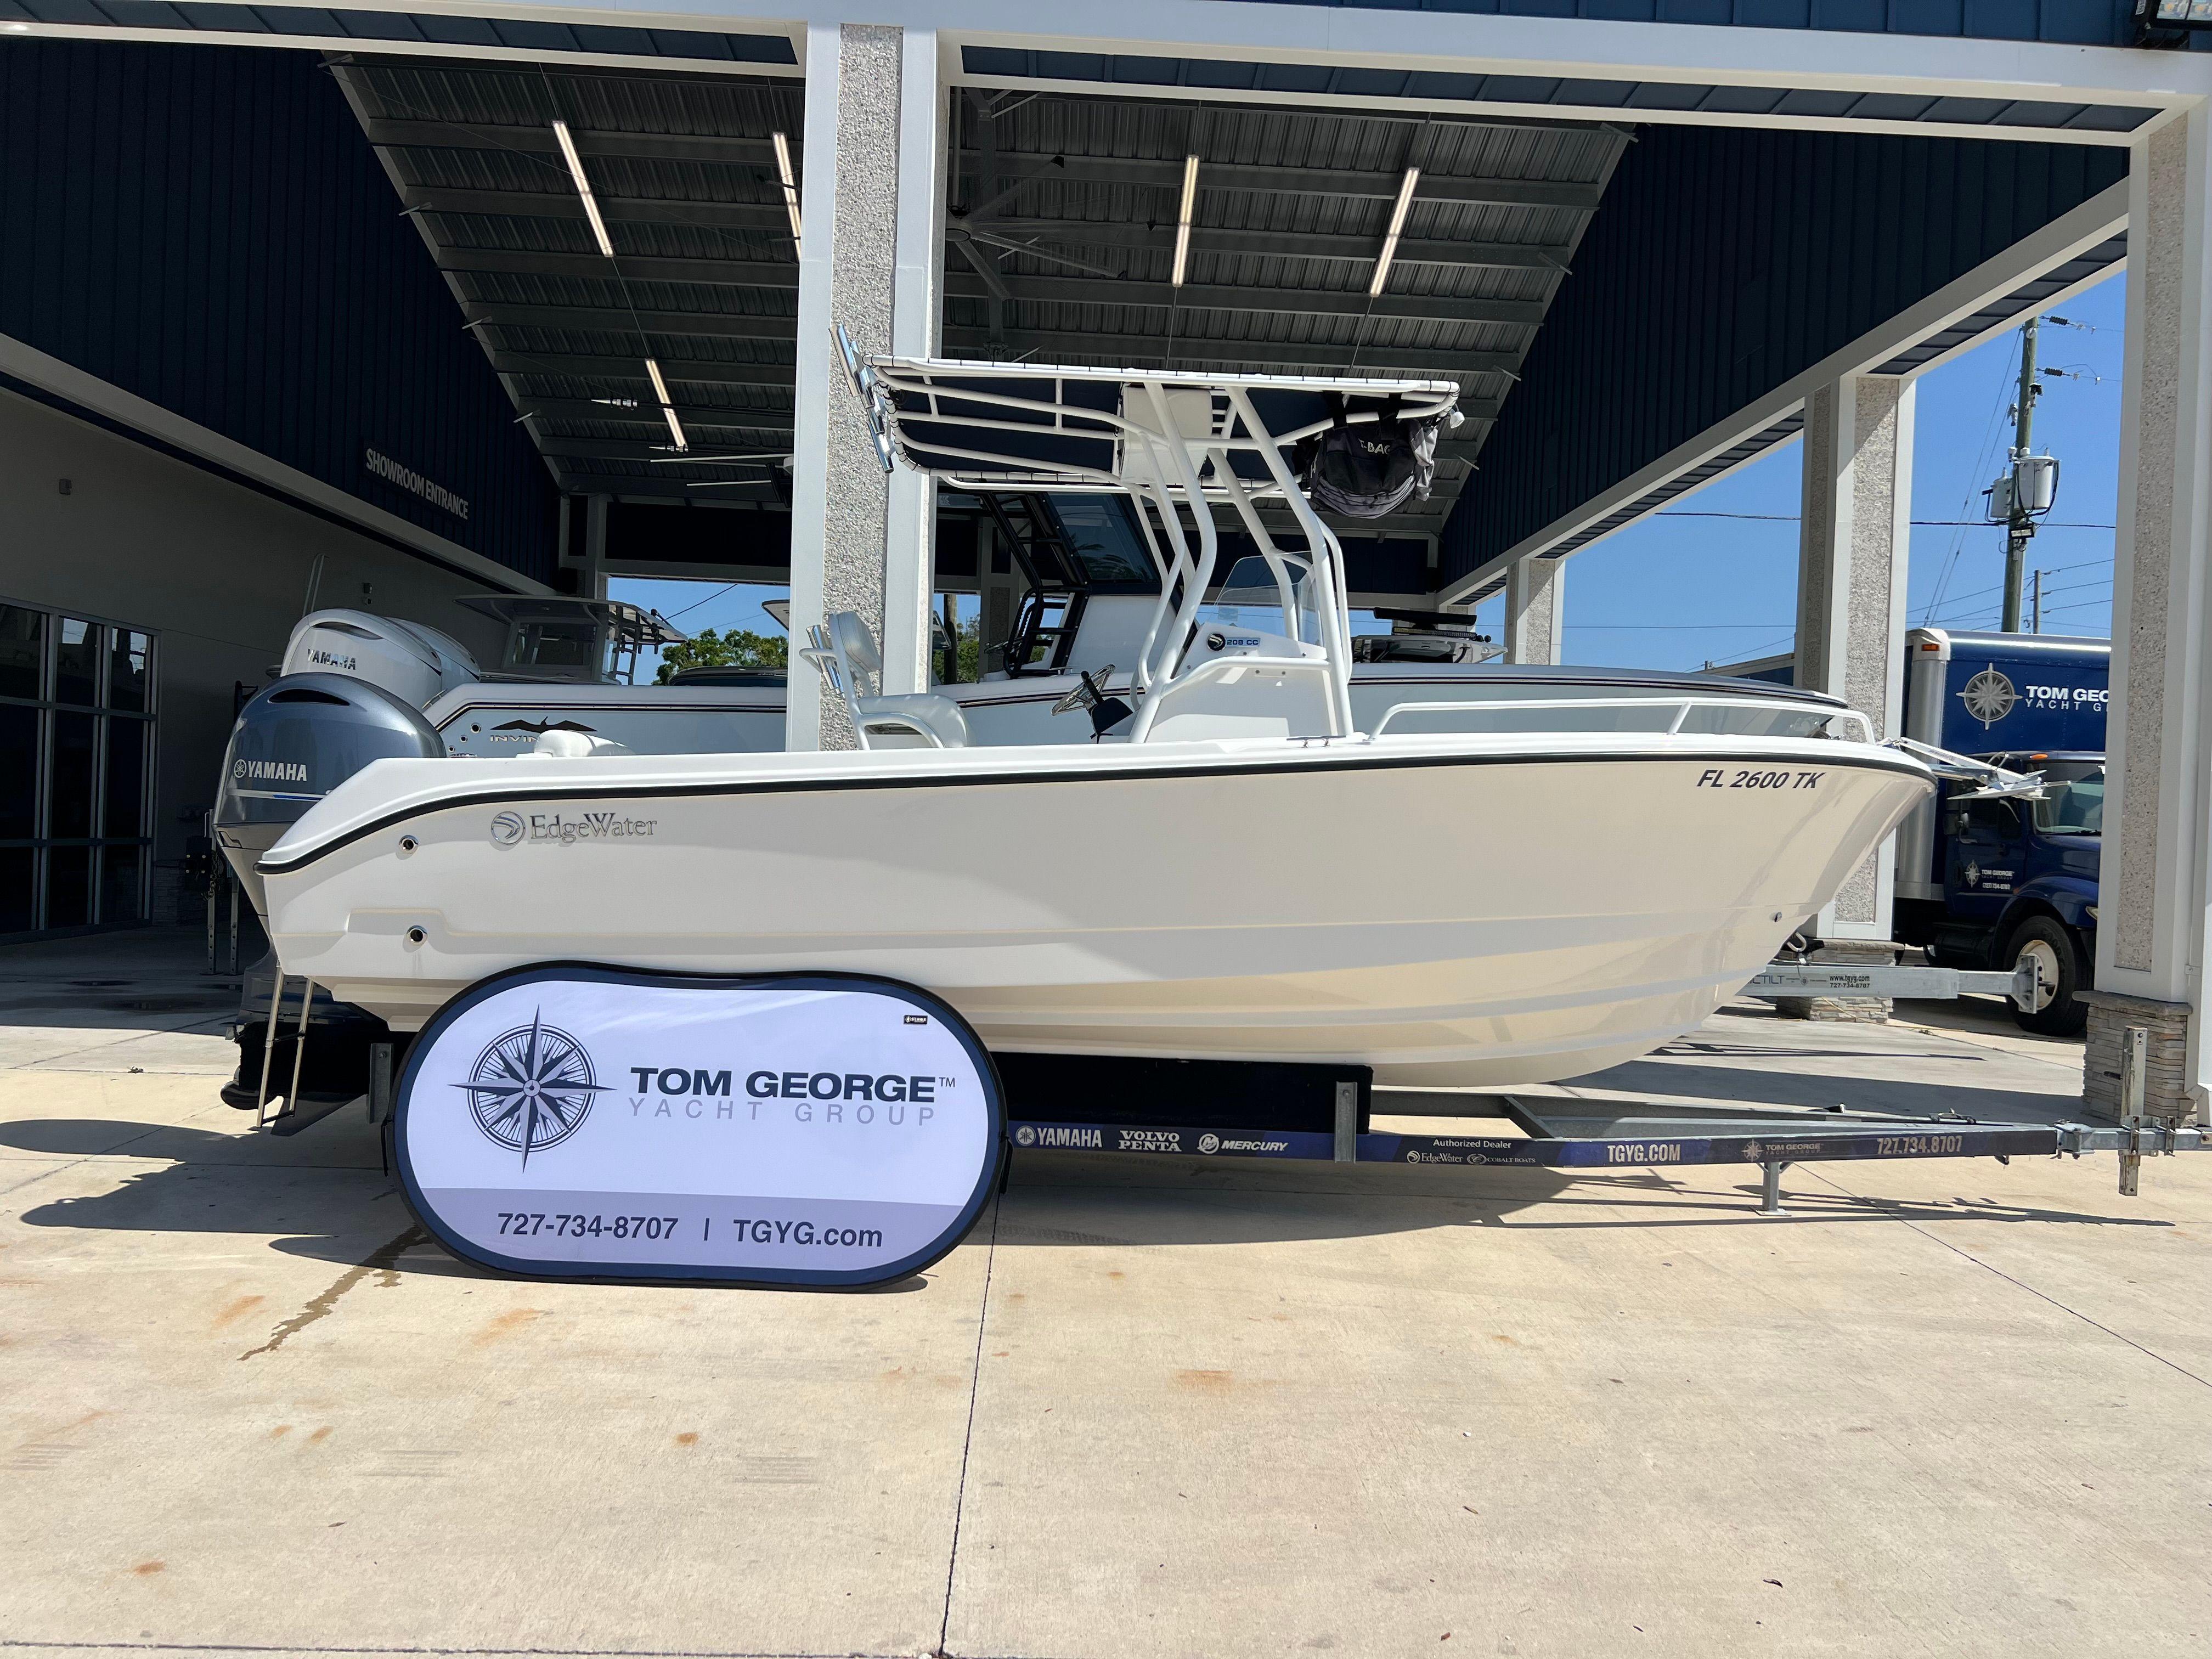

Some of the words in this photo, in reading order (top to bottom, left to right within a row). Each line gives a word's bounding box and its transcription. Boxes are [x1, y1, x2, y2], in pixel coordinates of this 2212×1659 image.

[365, 448, 425, 497] SHOWROOM
[425, 479, 469, 520] ENTRANCE
[307, 648, 356, 670] YAMAHA
[2025, 685, 2069, 700] TOM
[2025, 698, 2081, 710] YACHT
[248, 760, 307, 782] YAMAHA
[1696, 769, 1724, 788] FL
[1729, 770, 1790, 789] 2600
[1792, 772, 1827, 788] TK
[529, 812, 658, 844] EdgeWater
[1829, 974, 1870, 983] www.tgyg.com
[630, 1066, 732, 1096] TOM
[745, 1070, 935, 1103] GEORGE
[938, 1076, 956, 1088] TM
[629, 1097, 763, 1120] YACHT
[794, 1103, 935, 1126] GROUP
[1037, 1127, 1103, 1148] YAMAHA
[1118, 1140, 1182, 1152] PENTA
[1119, 1130, 1181, 1142] VOLVO
[1221, 1139, 1289, 1152] MERCURY
[1432, 1139, 1481, 1148] Authorized
[1483, 1139, 1512, 1148] Dealer
[1876, 1135, 1962, 1155] 727.734.8707
[1421, 1152, 1464, 1164] EdgeWater
[1607, 1144, 1681, 1163] TGYG.COM
[497, 1212, 680, 1239] 727-734-8707
[732, 1218, 883, 1247] TGYG.com
